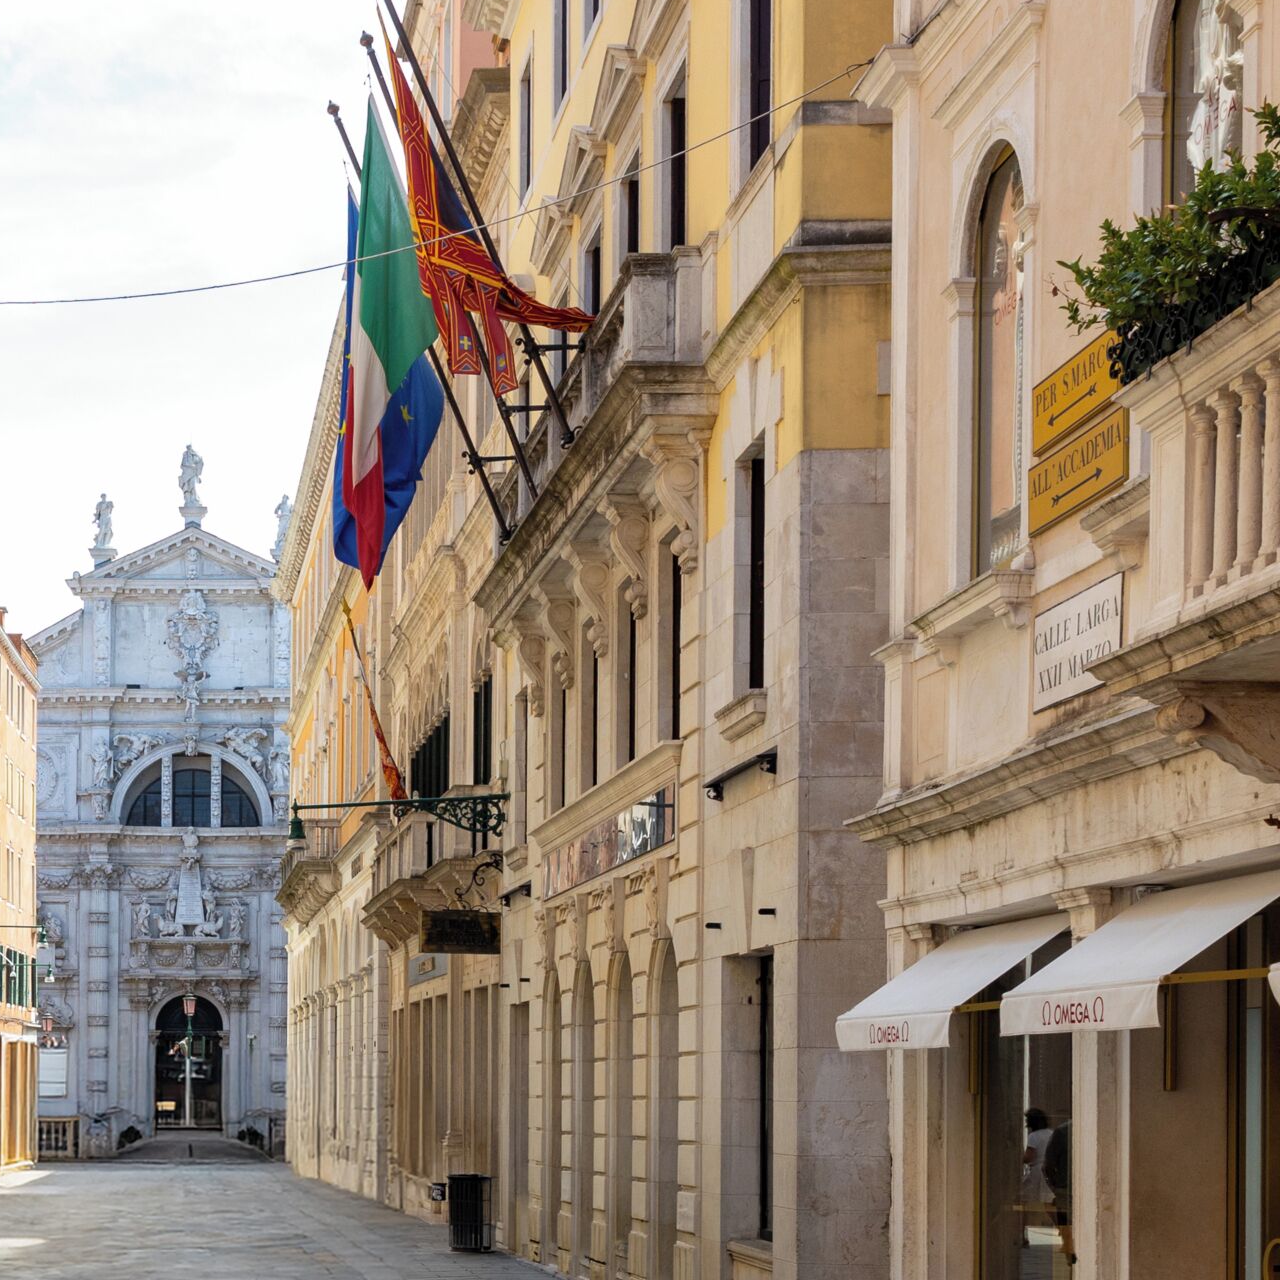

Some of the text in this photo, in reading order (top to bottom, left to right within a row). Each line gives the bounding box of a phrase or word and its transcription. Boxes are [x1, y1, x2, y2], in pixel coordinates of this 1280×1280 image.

[1035, 382, 1057, 418] PER
[1031, 420, 1122, 501] ALL'ACCADEMIA
[1034, 595, 1119, 656] CALLE LARGA
[1038, 662, 1062, 694] XXII
[1054, 1002, 1091, 1025] OMEGA
[877, 1025, 900, 1043] OMEGA
